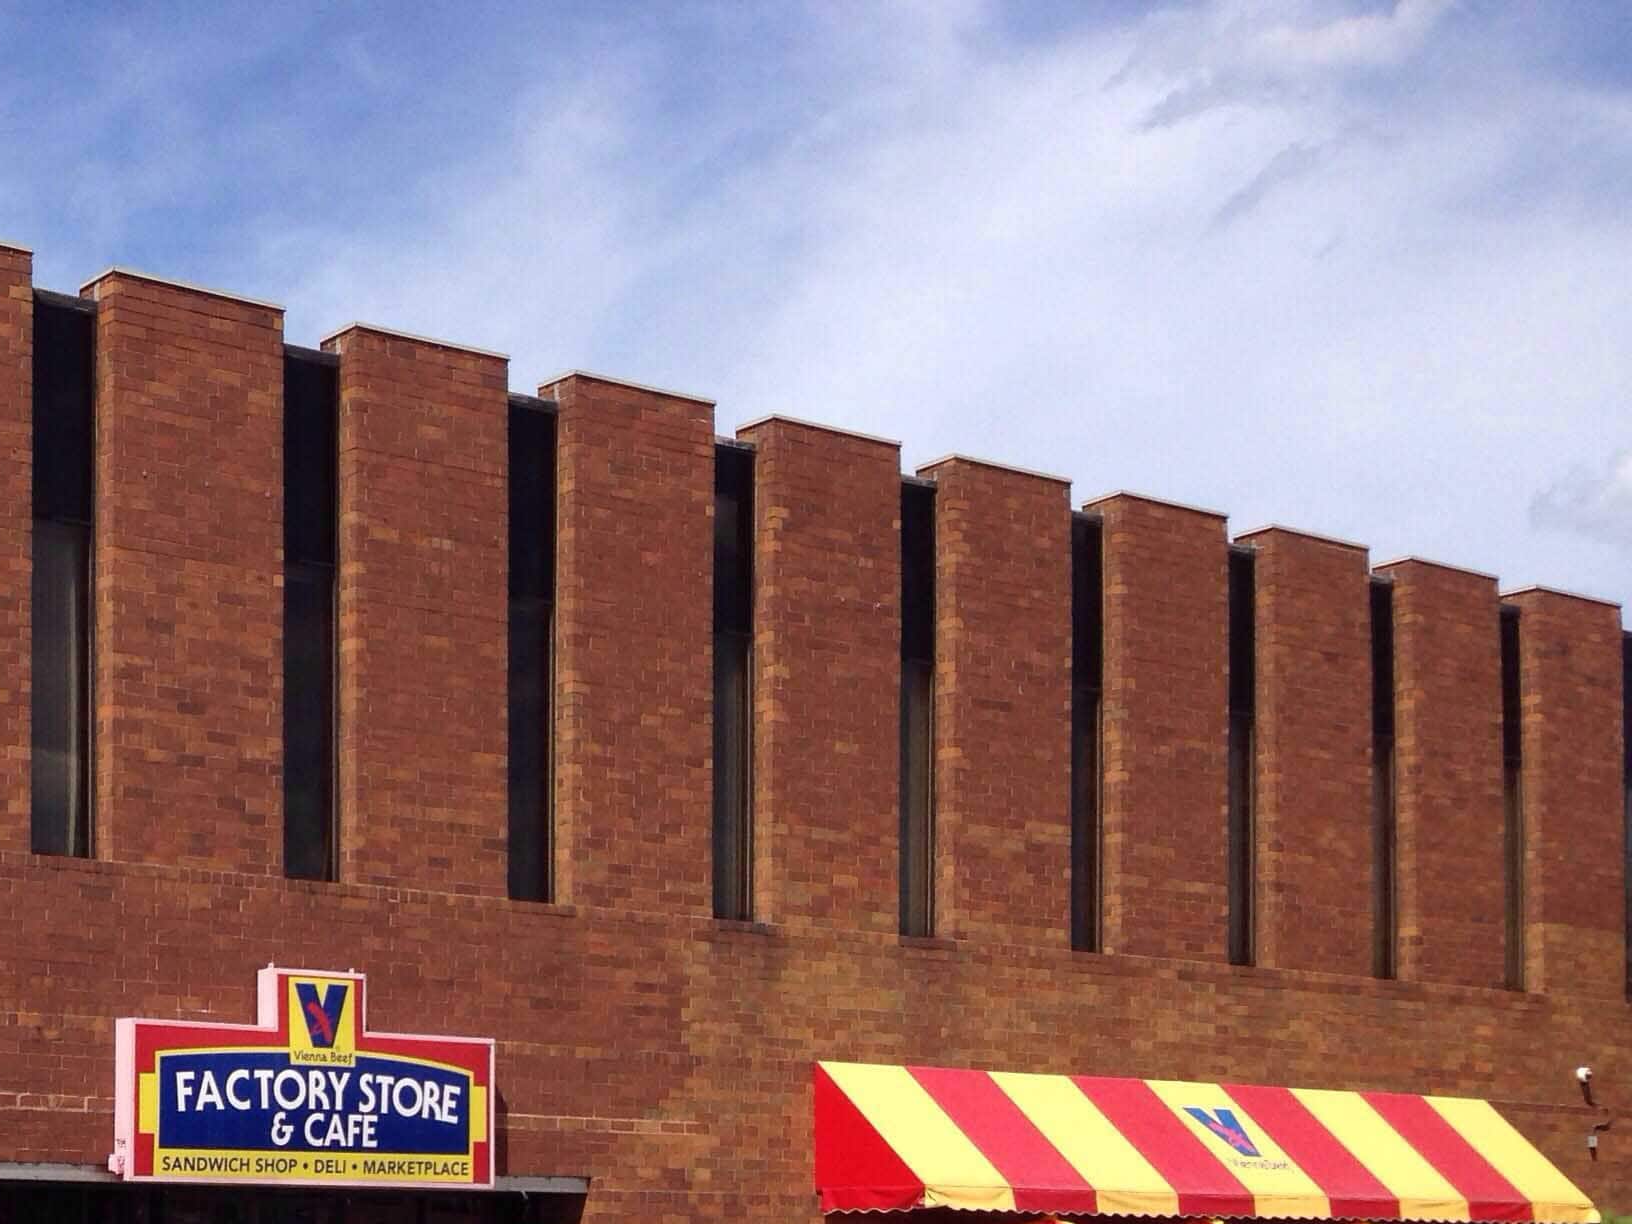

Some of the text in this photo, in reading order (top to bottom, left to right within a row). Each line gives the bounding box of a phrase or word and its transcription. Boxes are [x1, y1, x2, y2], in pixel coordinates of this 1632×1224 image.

[294, 1050, 352, 1065] Vienna Beef
[175, 1068, 462, 1124] FACTORY STORE
[270, 1111, 295, 1148] &
[161, 1156, 469, 1177] SANDWICH SHOP DELI MARKETPLACE
